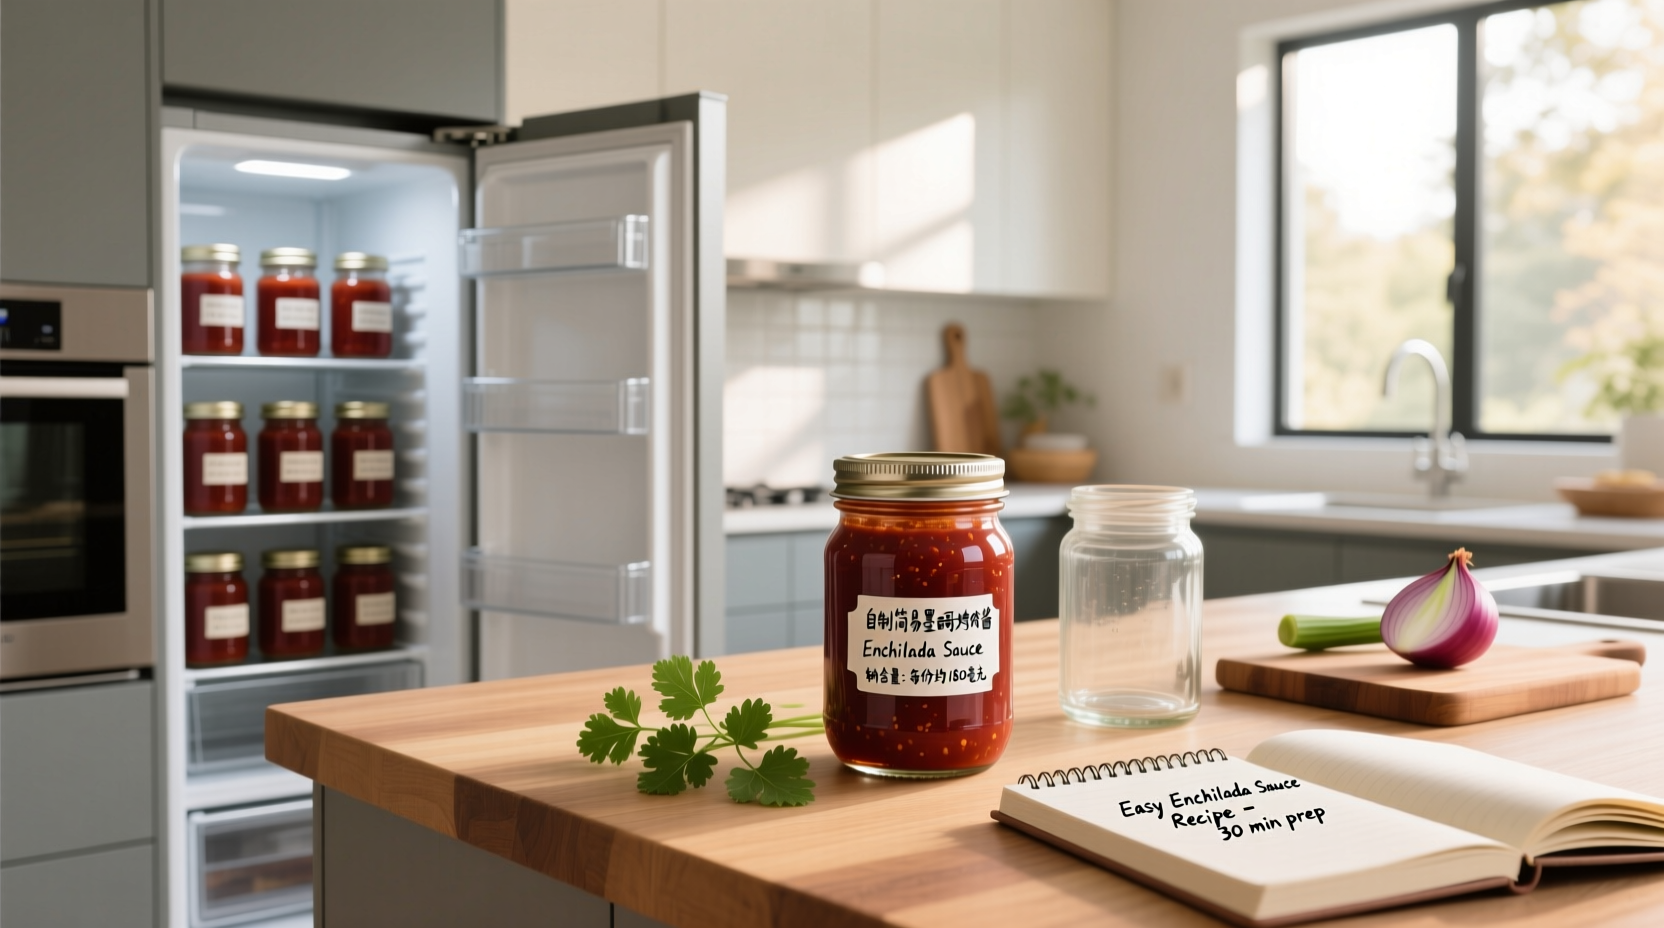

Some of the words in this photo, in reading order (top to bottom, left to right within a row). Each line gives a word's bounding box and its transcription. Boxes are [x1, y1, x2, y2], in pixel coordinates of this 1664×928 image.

[862, 639, 936, 659] Enchilada
[943, 640, 983, 658] Sauce
[1118, 800, 1164, 820] Easy
[1168, 782, 1253, 809] Enchilada
[1254, 779, 1301, 794] Sauce
[1171, 809, 1236, 829] Recipe
[1220, 824, 1244, 841] 30
[1248, 816, 1283, 834] min
[1285, 807, 1326, 832] prep
